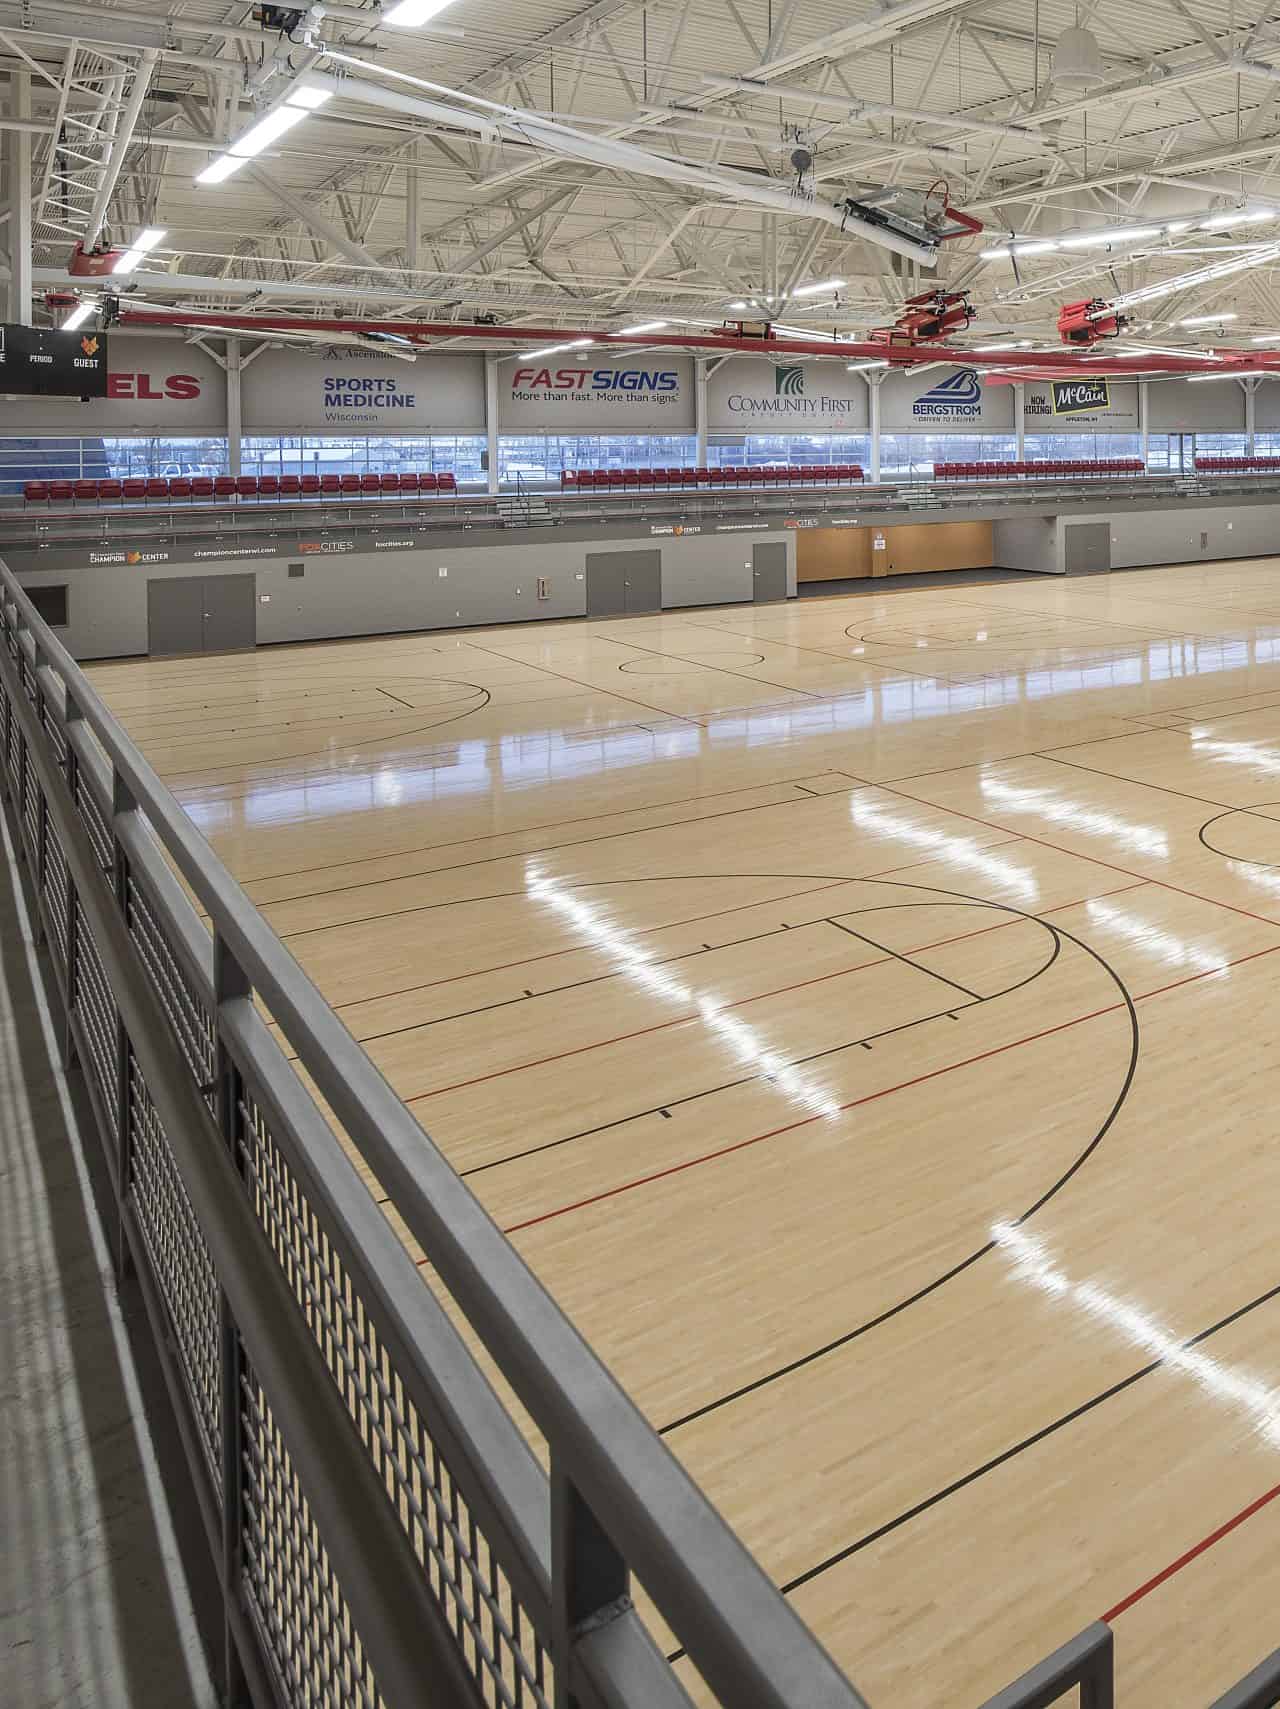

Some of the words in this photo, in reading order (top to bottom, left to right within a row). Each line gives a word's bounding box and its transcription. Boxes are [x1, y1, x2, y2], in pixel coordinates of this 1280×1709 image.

[30, 355, 52, 363] PERIOD
[74, 358, 98, 368] GUEST
[324, 378, 397, 392] SPORTS
[512, 368, 679, 391] FASTSIGNS
[324, 394, 416, 408] MEDICINE
[512, 391, 540, 401] More
[543, 391, 568, 401] than
[571, 391, 593, 401] fast.
[596, 392, 623, 402] More
[626, 392, 649, 402] than
[1056, 385, 1107, 408] McCain
[728, 395, 817, 412] COMMUNITY
[820, 396, 854, 412] FIRST
[912, 404, 981, 415] BERGSTROM
[325, 412, 378, 422] Wisconsin
[90, 555, 125, 563] CHAMPION
[142, 552, 169, 561] CENTER
